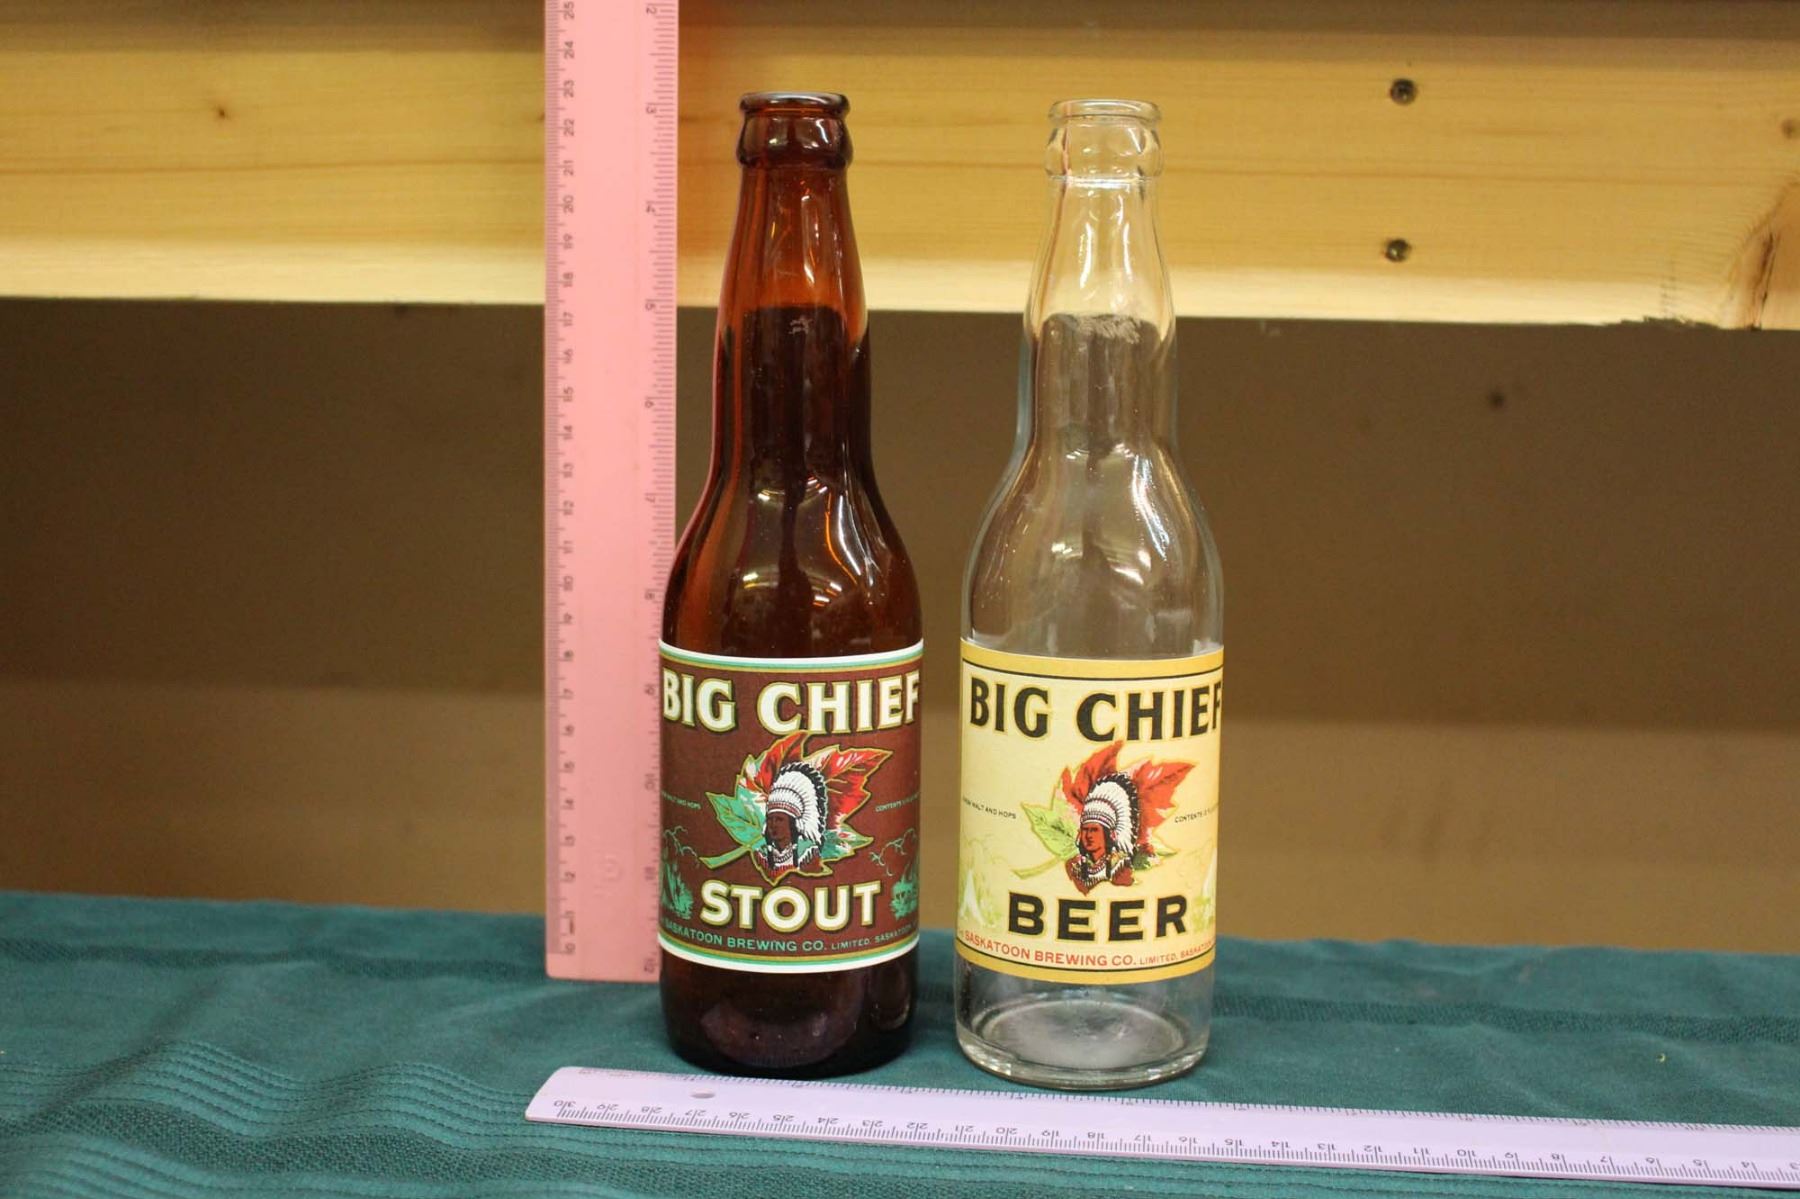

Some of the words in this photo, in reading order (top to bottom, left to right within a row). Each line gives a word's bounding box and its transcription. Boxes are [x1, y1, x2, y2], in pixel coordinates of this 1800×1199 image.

[563, 1, 575, 20] 25
[563, 41, 575, 59] 24
[563, 80, 575, 98] 23
[563, 119, 575, 137] 22
[563, 160, 574, 176] 21
[563, 195, 574, 214] 20
[563, 234, 573, 249] 19
[563, 272, 574, 288] 18
[563, 312, 574, 327] 17
[563, 387, 574, 402] 15
[563, 425, 573, 440] 14
[563, 501, 574, 515] 12
[563, 540, 573, 554] 11
[663, 668, 736, 732] BIG
[757, 670, 919, 735] CHIEF
[970, 677, 1049, 738] BIG
[1076, 681, 1222, 741] CHIEF
[700, 879, 881, 933] STOUT
[1008, 892, 1187, 942] BEER
[727, 937, 797, 952] BREWING
[802, 940, 827, 952] CO.
[964, 929, 1030, 960] SASKATOON
[1034, 949, 1107, 967] BREWING
[1111, 954, 1137, 967] CO.
[553, 1100, 576, 1108] 30
[597, 1103, 618, 1111] 29
[641, 1106, 662, 1114] 28
[685, 1109, 706, 1117] 27
[729, 1111, 750, 1119] 26
[773, 1114, 794, 1122] 25
[817, 1117, 839, 1125] 24
[862, 1120, 883, 1128] 23
[906, 1122, 928, 1130] 22
[954, 1125, 974, 1133] 21
[996, 1127, 1018, 1135] 20
[1042, 1129, 1060, 1137] 19
[1087, 1132, 1105, 1140] 18
[1134, 1134, 1151, 1142] 17
[1179, 1136, 1197, 1144] 16
[1225, 1138, 1243, 1146] 15
[1271, 1141, 1289, 1149] 14
[1317, 1143, 1335, 1151] 13
[1364, 1145, 1382, 1153] 12
[1413, 1147, 1430, 1155] 11
[1457, 1149, 1476, 1157] 10
